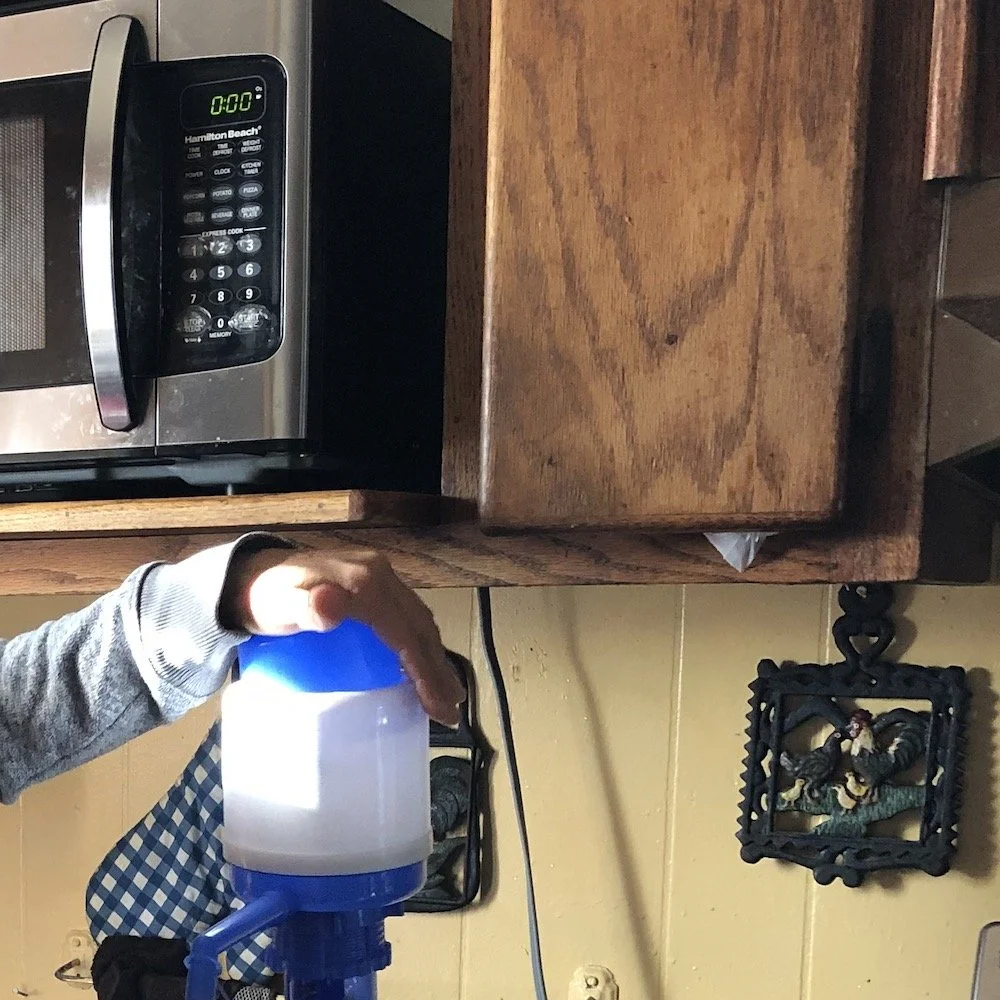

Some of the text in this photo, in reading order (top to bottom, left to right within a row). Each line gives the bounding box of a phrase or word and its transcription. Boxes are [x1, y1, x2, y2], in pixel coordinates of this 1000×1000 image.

[211, 92, 252, 115] 0:00
[184, 132, 227, 143] Hamilton
[214, 168, 230, 176] CLOCK
[213, 189, 232, 197] POTATO
[244, 186, 258, 194] PIZZA
[203, 227, 243, 237] EXPRESS COOK
[189, 268, 198, 281] 4
[217, 265, 226, 278] 5
[245, 263, 254, 276] 6
[190, 293, 197, 304] 7
[217, 290, 226, 302] 8
[245, 288, 254, 300] 9
[217, 318, 225, 329] 0
